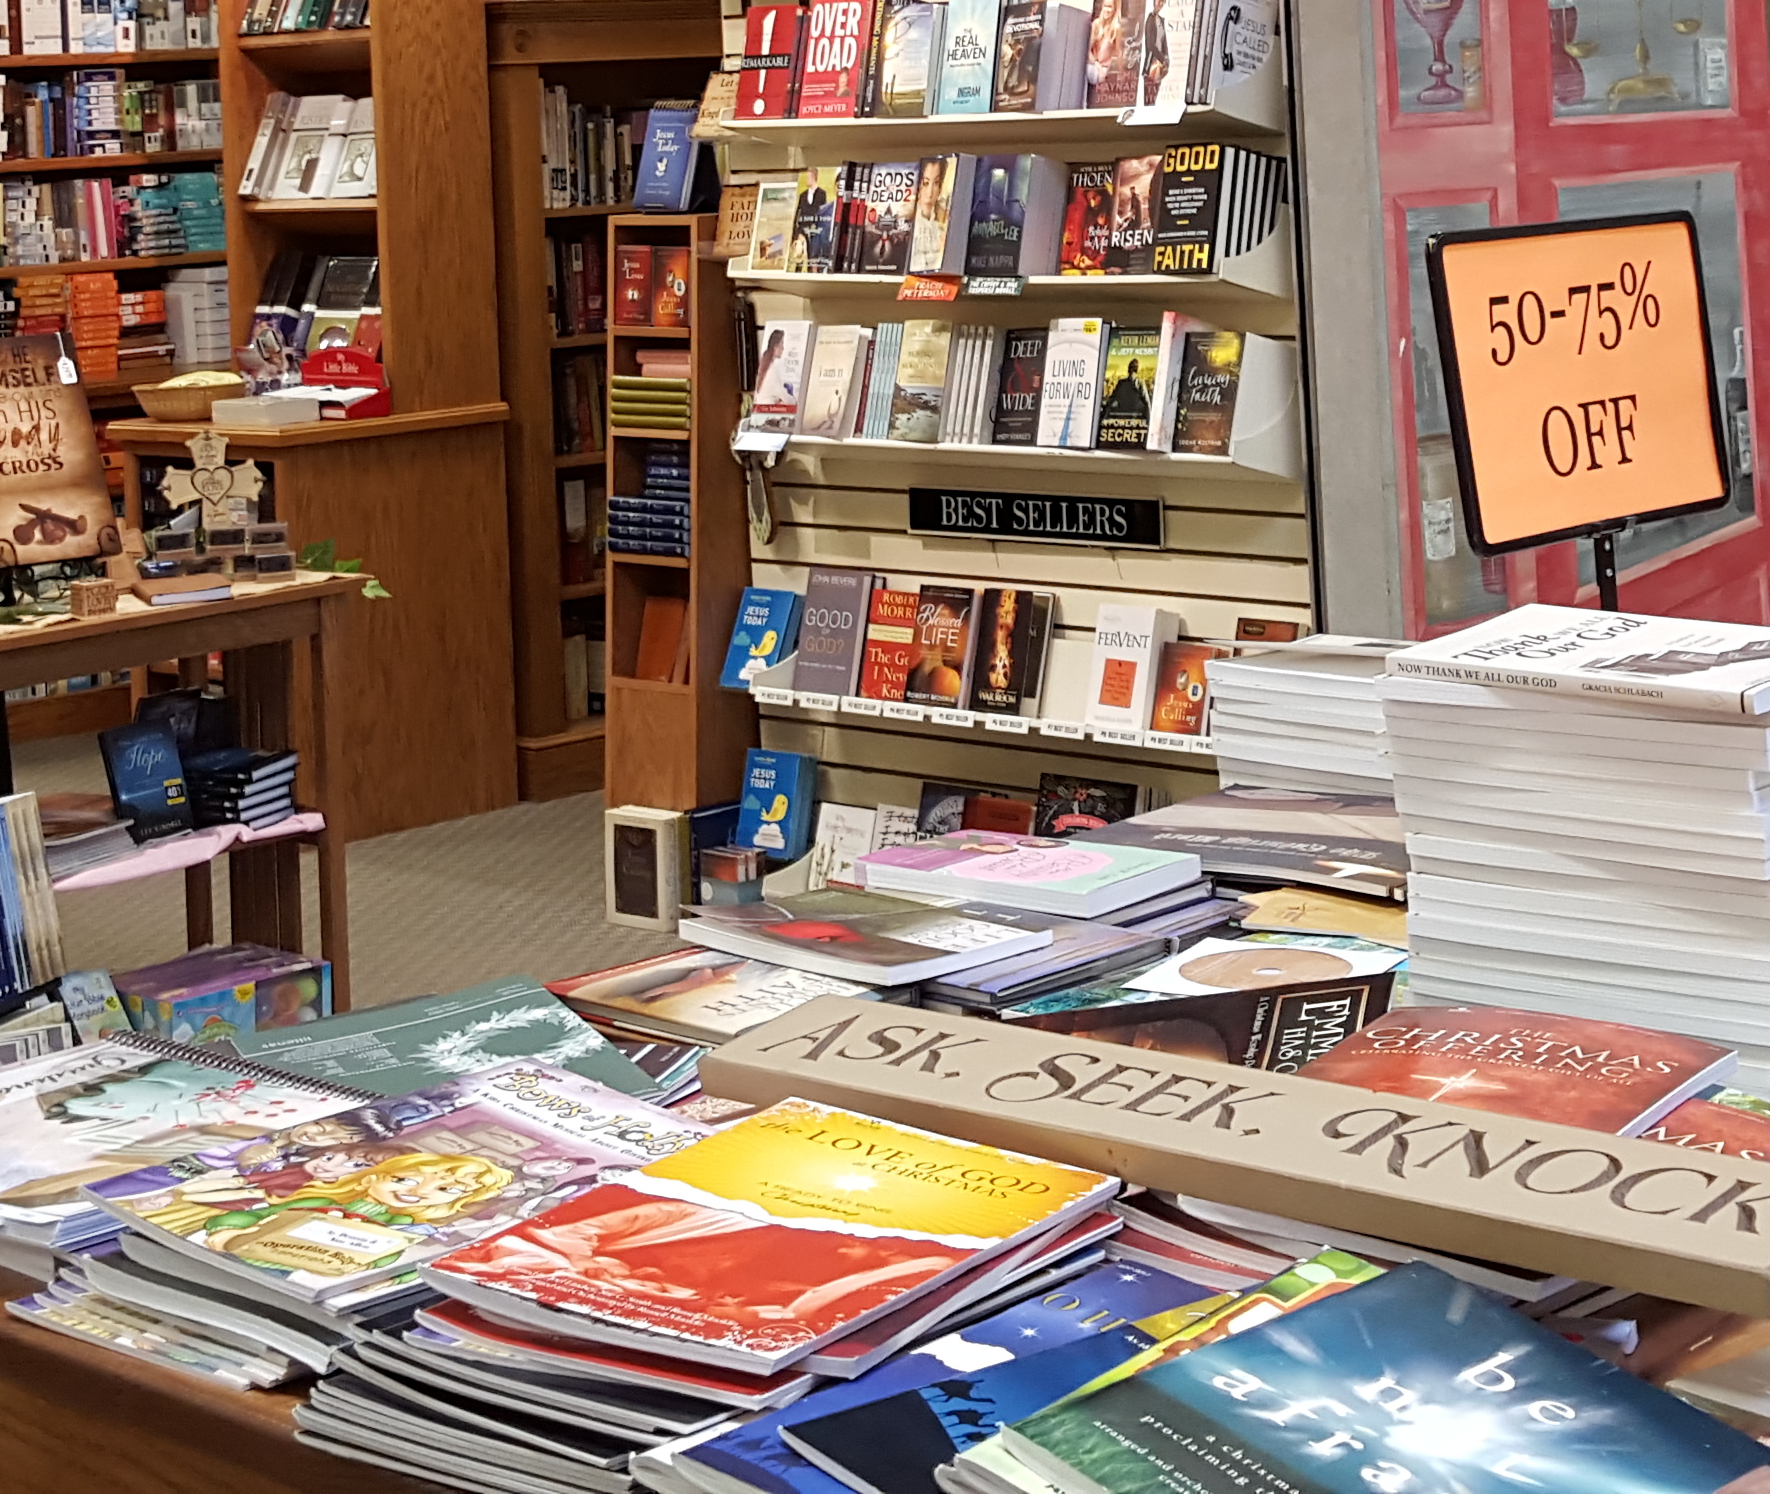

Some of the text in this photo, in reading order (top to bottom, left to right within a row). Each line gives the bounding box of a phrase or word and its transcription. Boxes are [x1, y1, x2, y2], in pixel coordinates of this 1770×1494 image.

[811, 1, 862, 38] OVER
[1239, 17, 1267, 36] JESUS
[954, 35, 980, 48] REAL
[1234, 32, 1270, 54] CALLED
[806, 37, 858, 73] LOAD
[946, 46, 987, 62] HEAVEN
[1163, 143, 1221, 174] GOOD
[872, 171, 915, 190] GOD'S
[1110, 228, 1155, 248] RISEN
[1153, 243, 1210, 272] FAITH
[1487, 259, 1661, 368] 50-75%
[1009, 340, 1043, 359] DEEP
[1051, 358, 1086, 378] LIVING
[1001, 392, 1037, 411] WIDE
[1099, 428, 1148, 443] SECRET
[1540, 394, 1640, 479] OFF
[938, 494, 1129, 537] BEST SELLERS
[882, 592, 919, 606] ROBERT
[742, 615, 769, 626] TODAY
[743, 606, 770, 617] JESUS
[805, 607, 853, 630] GOOD
[916, 603, 967, 628] Blessed
[805, 635, 845, 655] GOD?
[920, 627, 960, 648] LIFE
[1097, 629, 1151, 650] FERVENT
[1452, 632, 1555, 665] Thank
[1514, 615, 1649, 663] Our God
[869, 647, 892, 664] The
[1397, 662, 1558, 690] NOW THANK WE ALL OUR GOD
[1167, 693, 1194, 709] Jesus
[1161, 707, 1198, 726] Calling
[749, 777, 776, 791] TODAY
[750, 767, 777, 779] JESUS
[1277, 1026, 1309, 1062] HAS
[1509, 1028, 1557, 1040] THE
[1365, 1026, 1680, 1076] CHRISTMAS
[1373, 1038, 1642, 1080] OFFERING
[757, 1014, 961, 1083] ASK,
[986, 1041, 1287, 1141] SEEK,
[491, 1074, 701, 1157] Bows Holly
[806, 1127, 1051, 1198] LOVE of GOD
[870, 1161, 1015, 1202] CHRISTMAS
[1459, 1348, 1576, 1427] be
[1137, 1413, 1252, 1486] proclaiming
